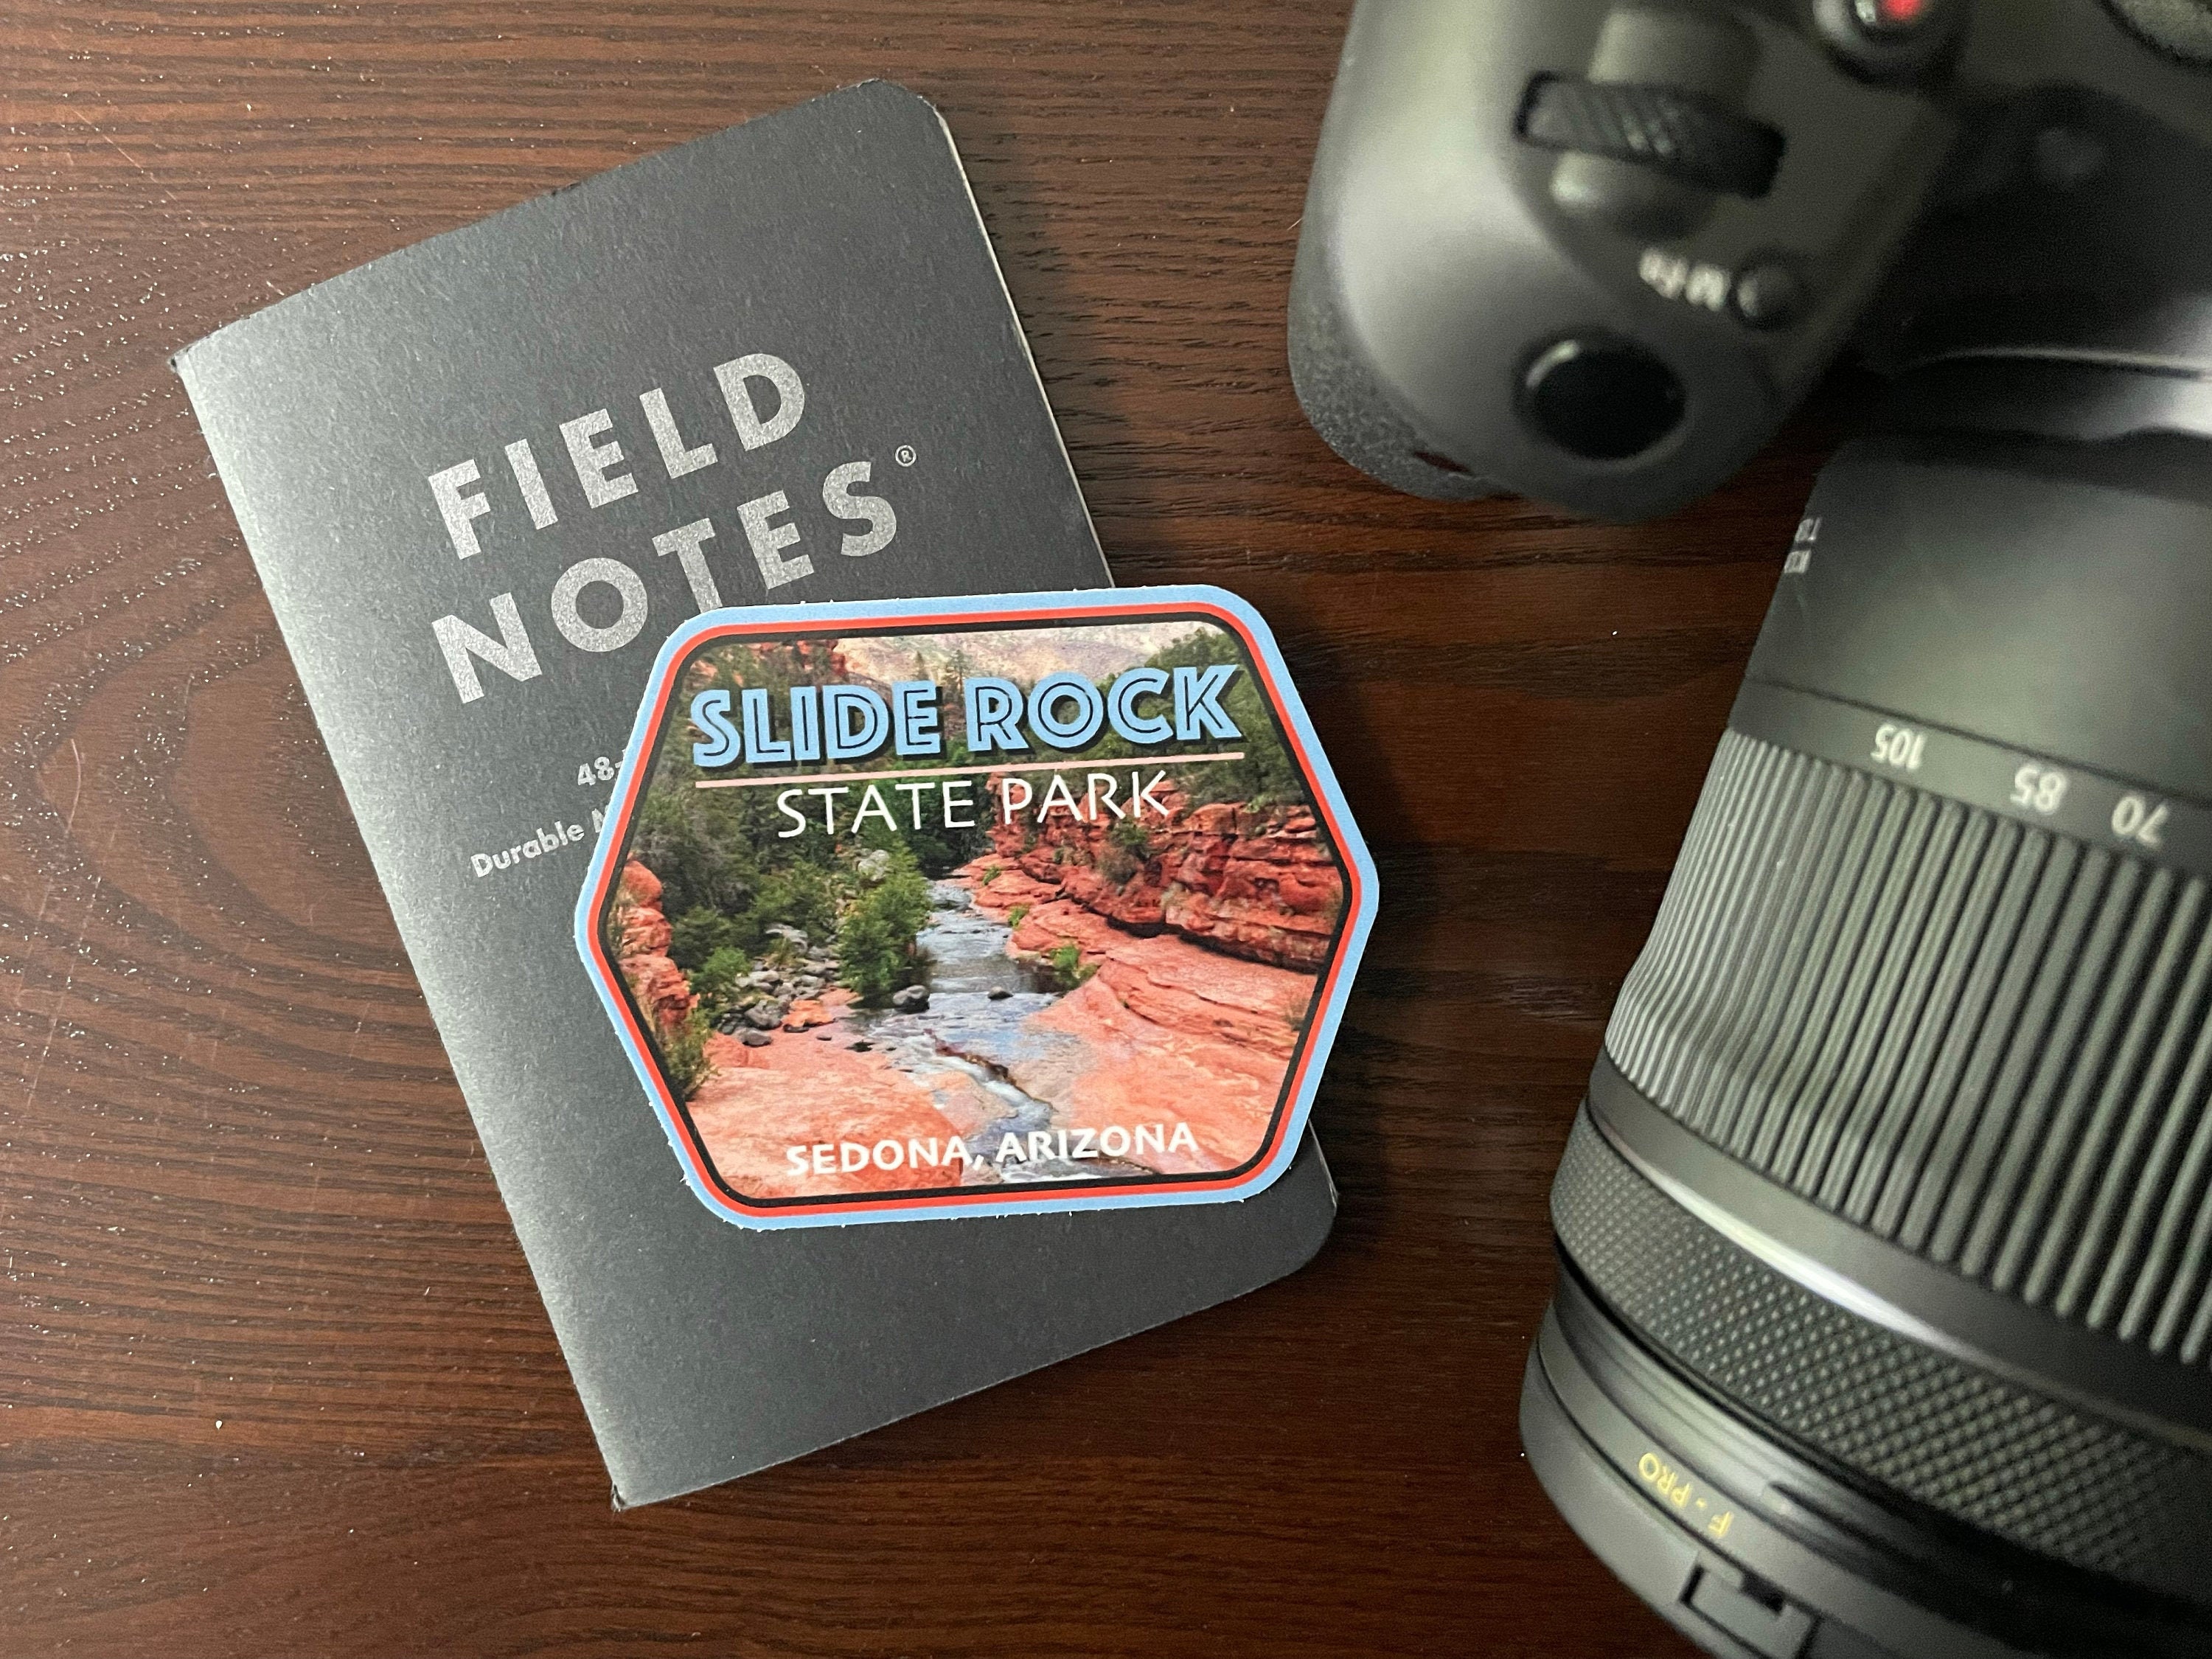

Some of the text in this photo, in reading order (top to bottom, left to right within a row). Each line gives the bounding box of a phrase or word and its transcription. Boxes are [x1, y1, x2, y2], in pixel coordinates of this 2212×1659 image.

[428, 353, 805, 560] FIELD
[692, 664, 1243, 768] SLIDE ROCK
[577, 748, 628, 786] 48-
[1871, 723, 2170, 849] 70 85 105
[776, 770, 1169, 838] STATE PARK
[470, 820, 585, 877] Durable
[785, 1121, 1200, 1177] SEDONA, ARIZONA
